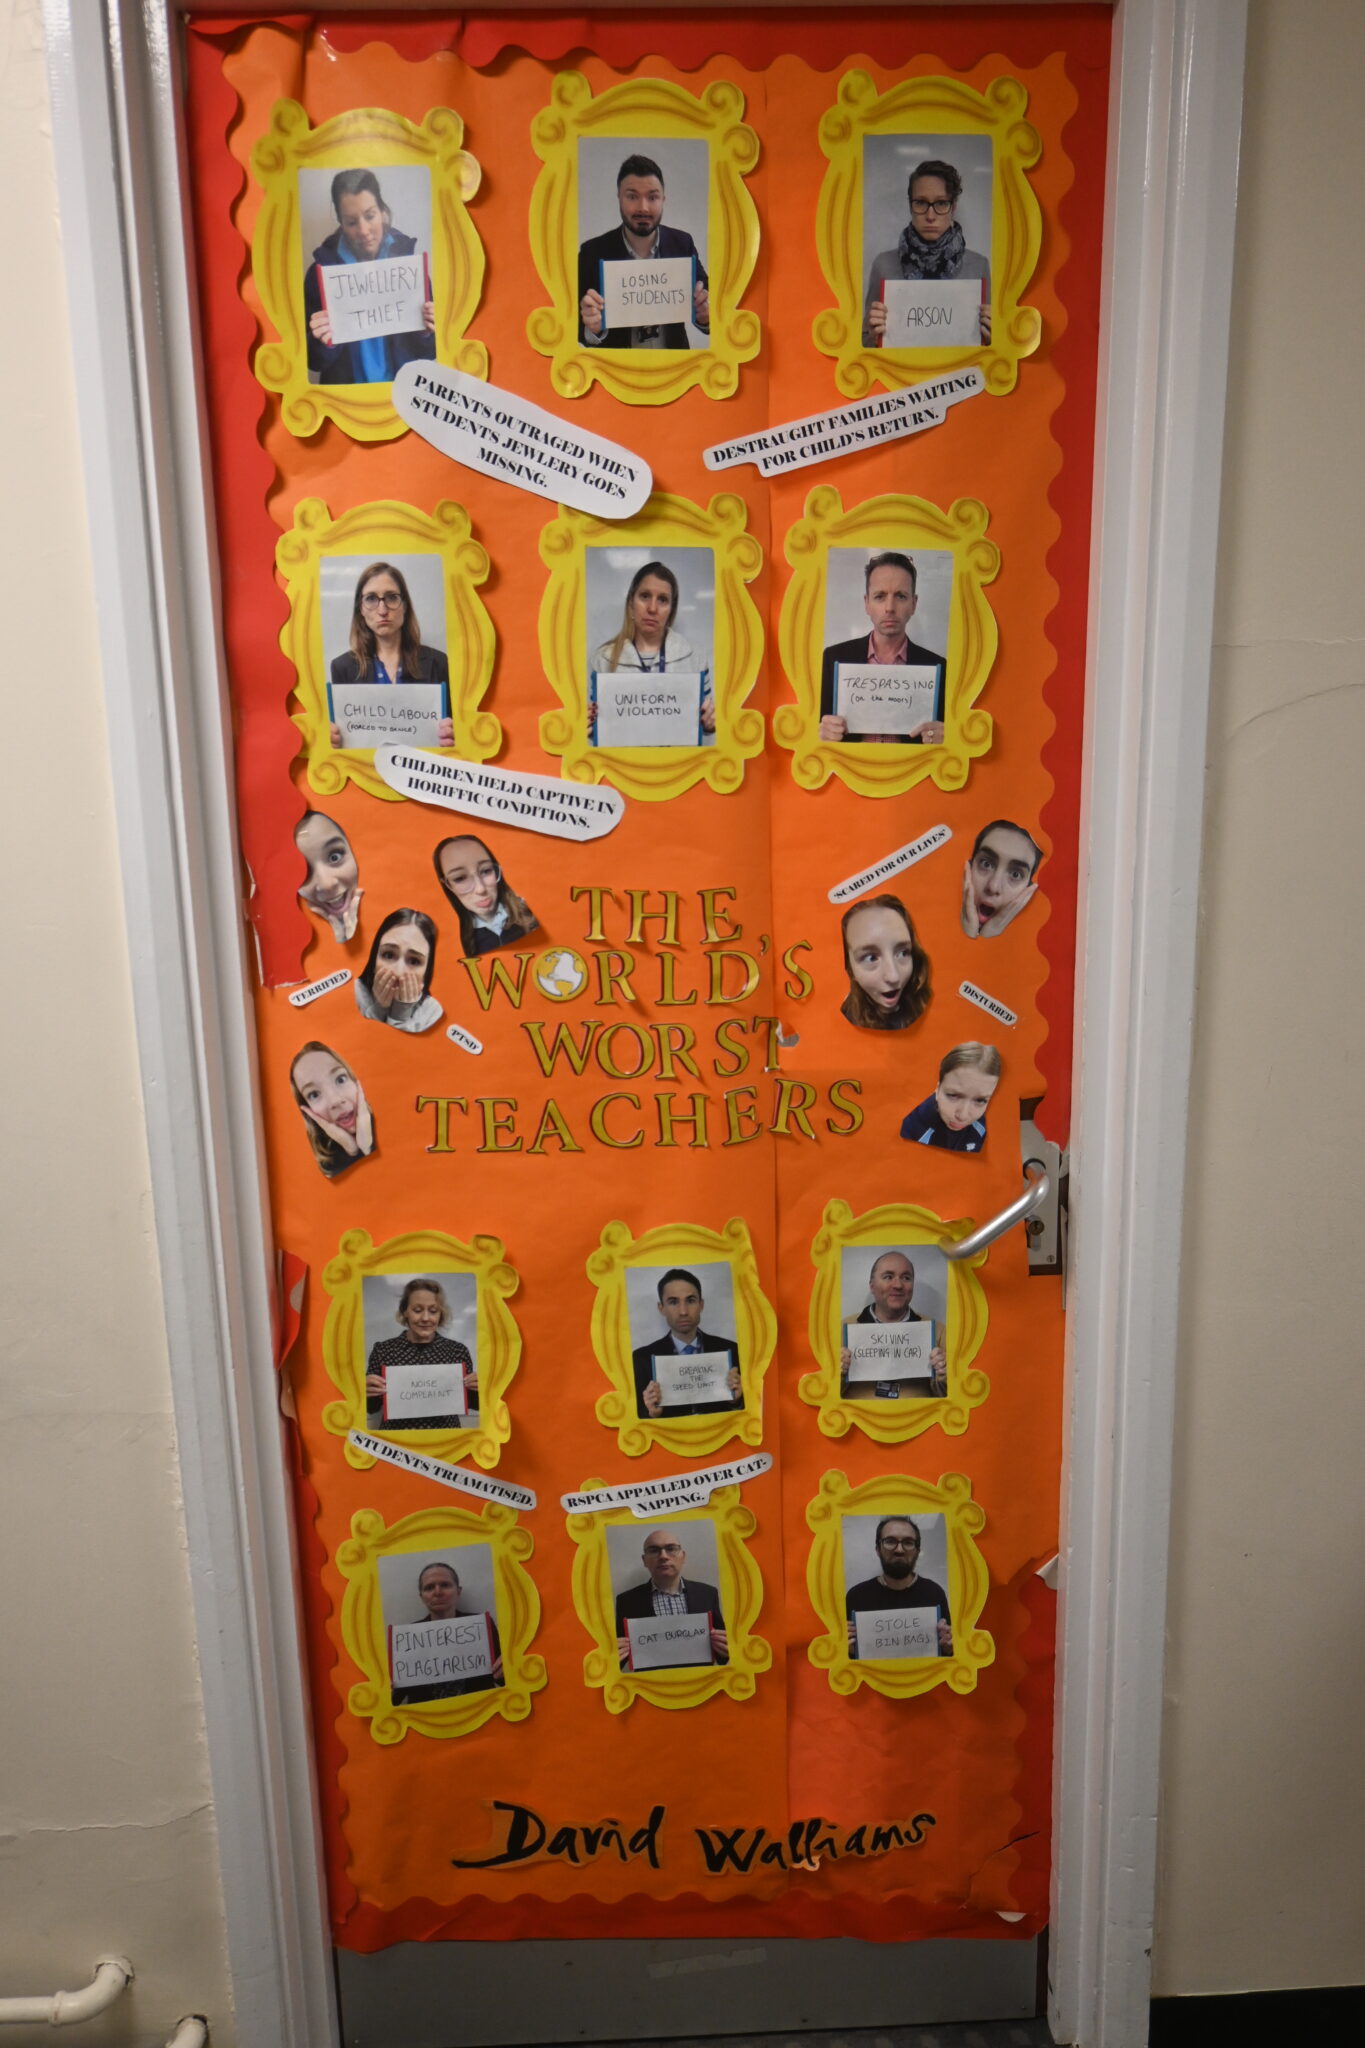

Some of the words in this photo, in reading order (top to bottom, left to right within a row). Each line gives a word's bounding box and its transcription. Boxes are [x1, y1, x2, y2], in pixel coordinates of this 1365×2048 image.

[328, 266, 418, 300] JEWELLERY
[622, 272, 668, 288] LOSING
[622, 289, 685, 306] STUDENTS
[347, 300, 405, 329] THIEF
[907, 306, 953, 328] ARSON
[414, 374, 493, 418] PARENTS
[494, 411, 585, 459] OUTRAGED
[588, 450, 639, 483] WHEN
[713, 420, 826, 463] DESTRAUGHT
[828, 397, 906, 430] FAMILIES
[908, 374, 977, 407] WAITING
[410, 396, 500, 444] STUDENTS
[501, 437, 584, 479] JEWLERY
[582, 472, 626, 500] GOES
[761, 451, 798, 470] FOR
[799, 429, 866, 459] CHILD'S
[868, 407, 940, 438] RETURN.
[477, 447, 548, 488] MISSING.
[843, 677, 935, 692] TRESPASSING
[871, 694, 883, 702] the
[343, 703, 387, 717] CHILD
[390, 707, 438, 720] LABOUR
[615, 693, 677, 705] UNIFORM
[616, 706, 681, 717] VIOLATION
[346, 721, 376, 733] (FORCED
[390, 754, 475, 785] CHILDREN
[476, 774, 523, 796] HELD
[524, 785, 595, 810] CAPTIVE
[597, 801, 616, 815] IN
[407, 776, 486, 806] HORIFFIC
[486, 795, 591, 829] CONDITIONS.
[874, 861, 896, 878] FOR
[896, 848, 918, 865] OUR
[570, 886, 743, 946] THE
[520, 1015, 783, 1081] WORST
[415, 1078, 865, 1154] TEACHERS
[853, 1346, 890, 1359] (SLEEPING
[893, 1347, 901, 1358] IN
[903, 1346, 922, 1359] CAR)
[870, 1333, 910, 1345] SKIVING
[400, 1389, 454, 1401] COMPLAINT
[411, 1379, 437, 1388] NOISE
[432, 1465, 533, 1507] TRUAMATISED.
[567, 1494, 615, 1509] RSPCA
[615, 1478, 692, 1500] APPAULED
[692, 1468, 735, 1486] OVER
[734, 1458, 768, 1476] CAT-
[636, 1491, 706, 1514] NAPPING.
[395, 1621, 485, 1653] PINTEREST
[638, 1633, 658, 1646] CAT
[665, 1628, 706, 1641] BURGLAR
[875, 1617, 922, 1633] STOLE
[876, 1636, 900, 1648] BIN
[903, 1632, 930, 1647] BAGS
[395, 1654, 487, 1681] PLAGIARISM
[451, 1800, 666, 1869] David
[694, 1814, 937, 1873] Walliams
